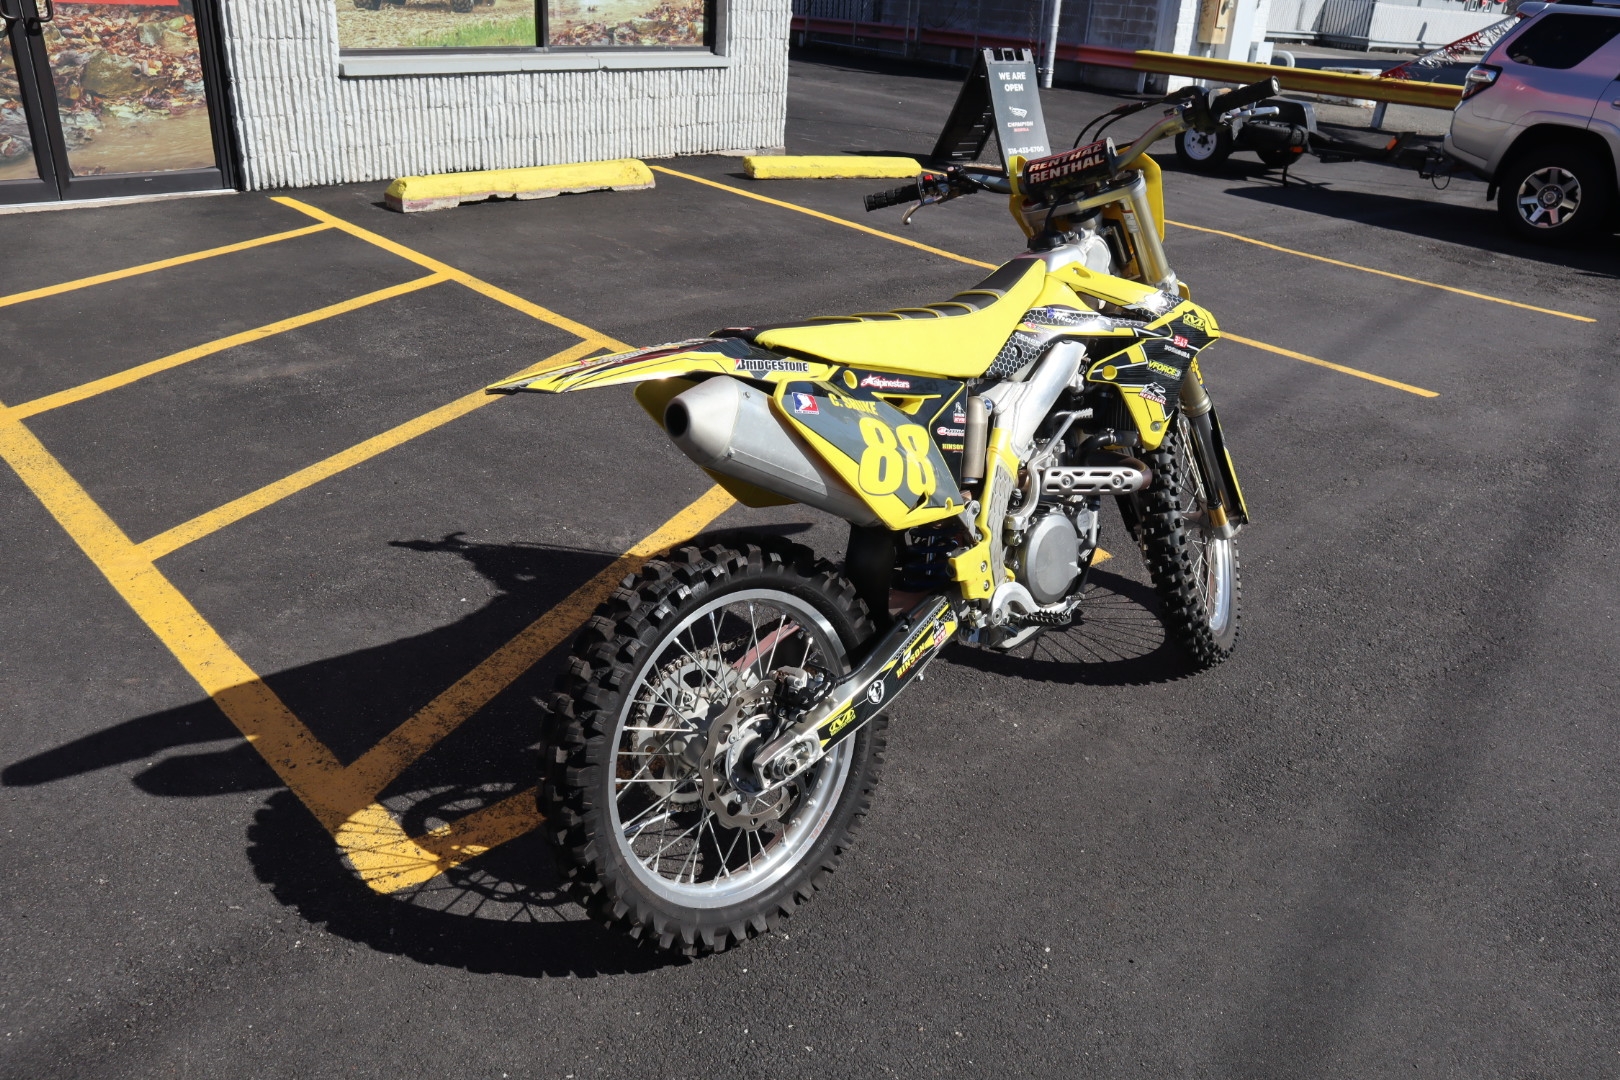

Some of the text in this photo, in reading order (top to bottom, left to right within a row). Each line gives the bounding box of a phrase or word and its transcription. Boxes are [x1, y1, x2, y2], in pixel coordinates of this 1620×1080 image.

[998, 72, 1026, 80] WE ARE
[1004, 84, 1024, 92] OPEN
[1028, 144, 1103, 172] RENTHAL
[1030, 153, 1105, 184] RENTHAL
[735, 358, 809, 372] BRIDGESTONE
[868, 376, 910, 389] alpinestars
[1139, 392, 1166, 405] RENTHAL
[858, 417, 936, 496] 88
[896, 642, 926, 679] HINSON
